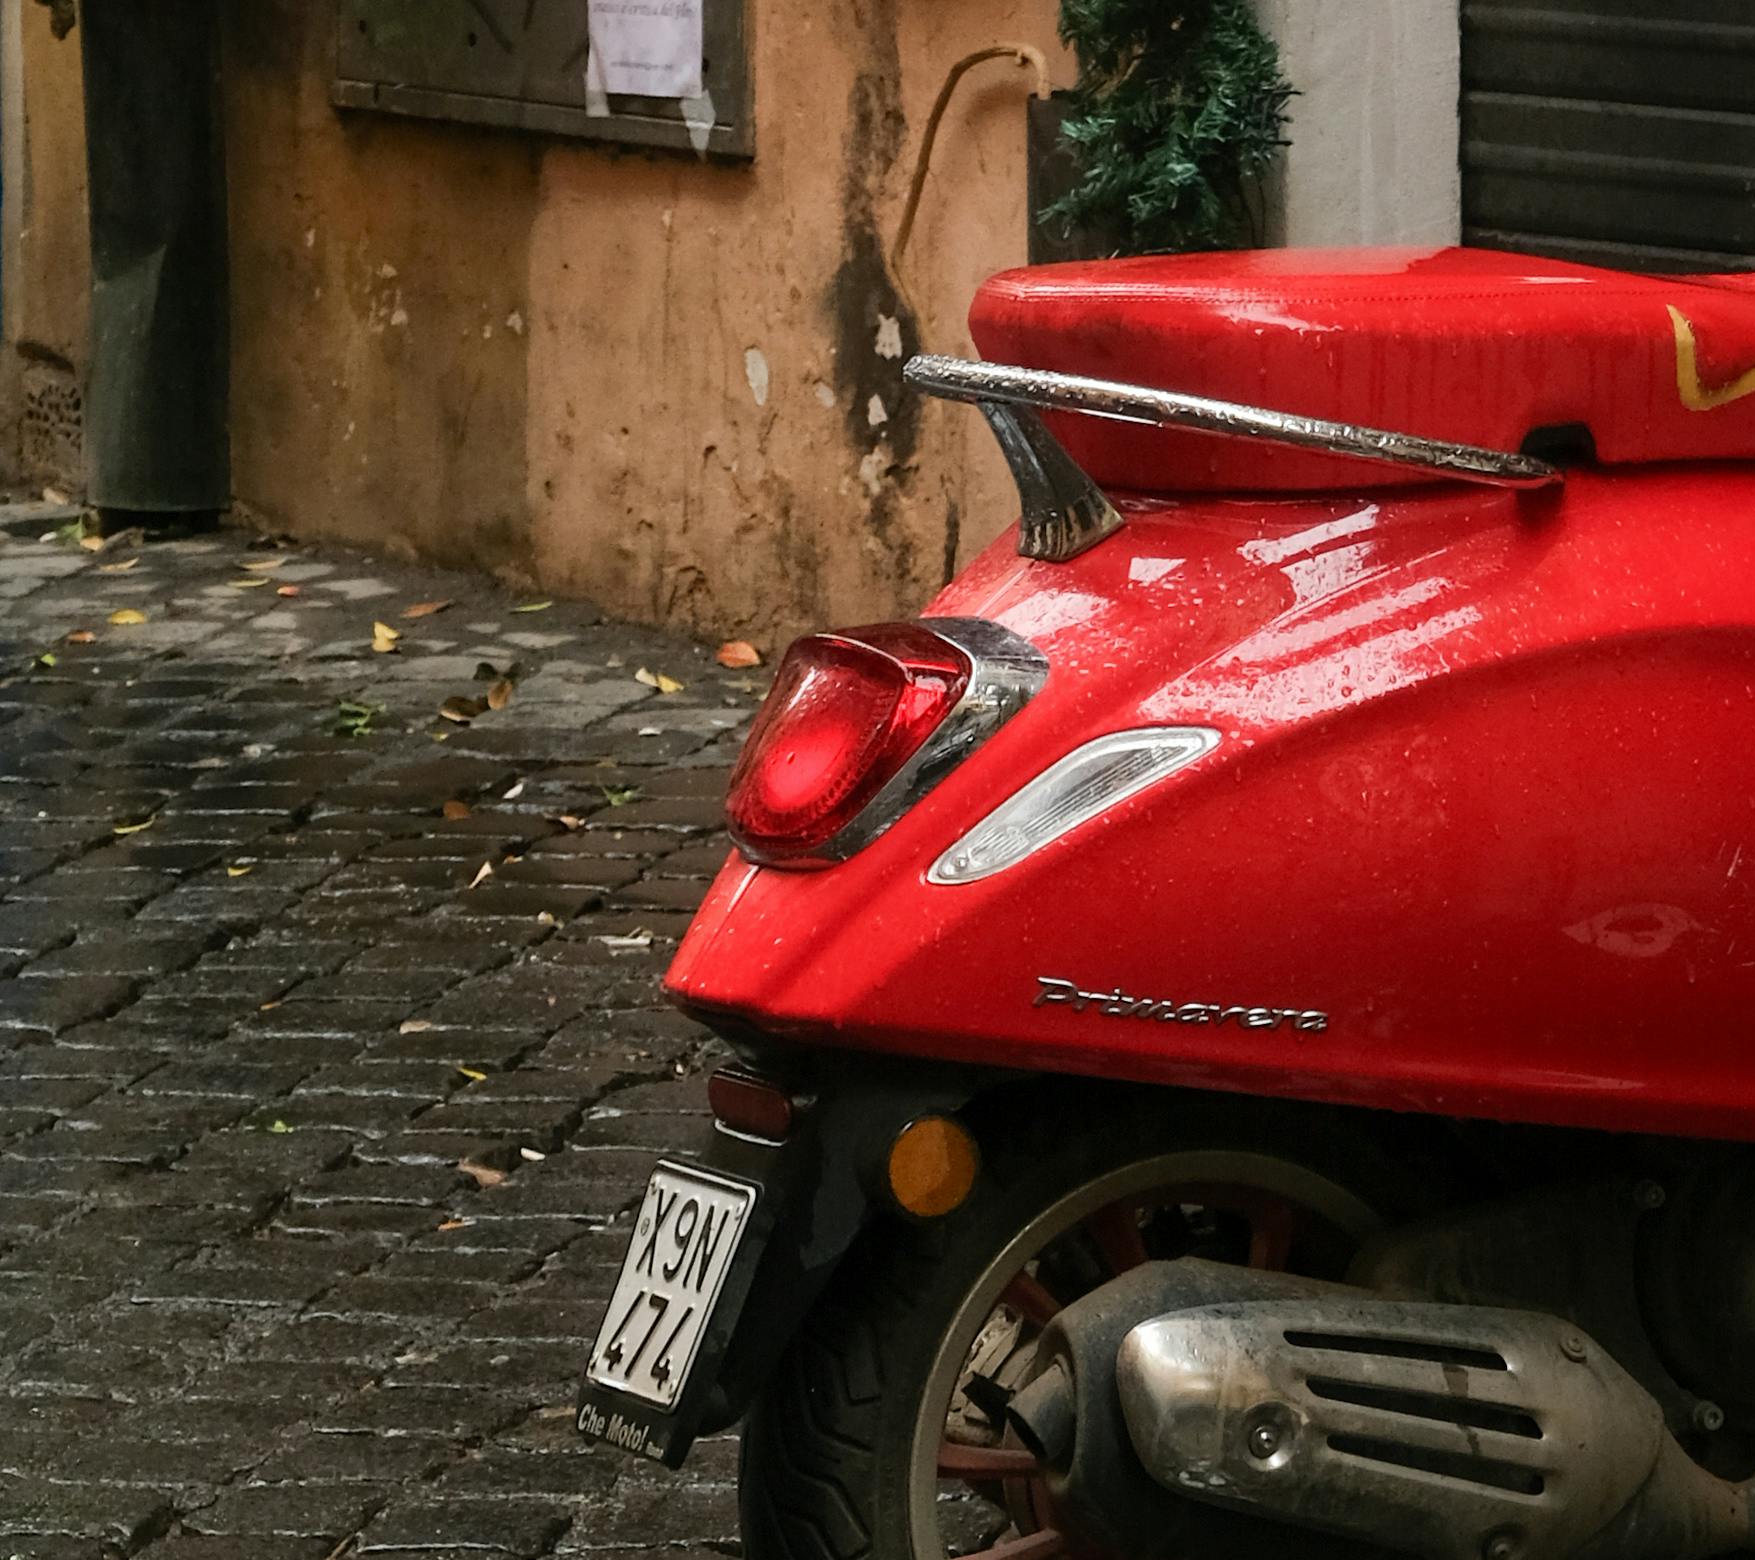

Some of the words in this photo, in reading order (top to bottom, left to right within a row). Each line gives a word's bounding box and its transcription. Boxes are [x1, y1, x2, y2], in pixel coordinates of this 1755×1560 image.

[1033, 975, 1328, 1032] Primavera
[634, 1186, 731, 1294] X9N
[602, 1288, 695, 1391] 474
[577, 1403, 605, 1437] Che
[605, 1412, 650, 1452] Moto!
